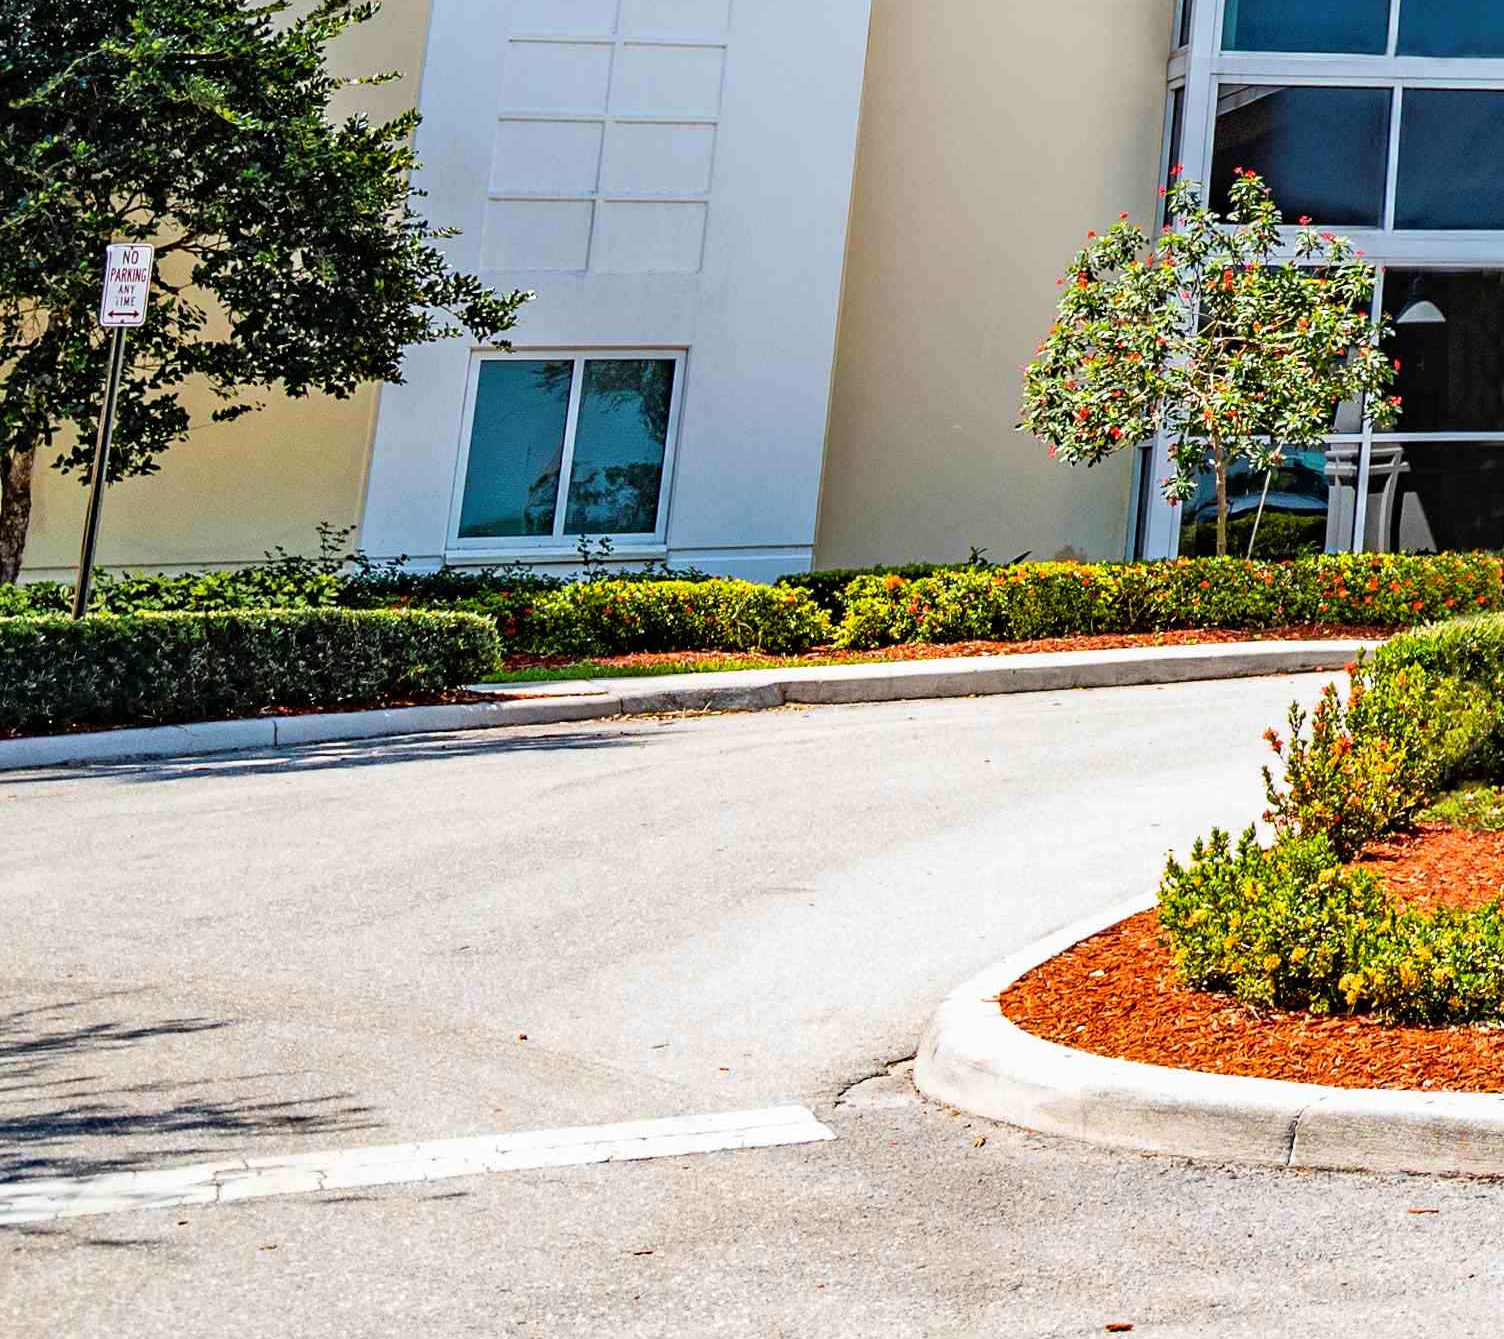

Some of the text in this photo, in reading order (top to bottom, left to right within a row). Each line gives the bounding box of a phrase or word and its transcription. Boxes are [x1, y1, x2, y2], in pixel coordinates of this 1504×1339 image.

[122, 250, 139, 265] NO
[110, 267, 147, 283] PARKING
[118, 284, 135, 295] ANY
